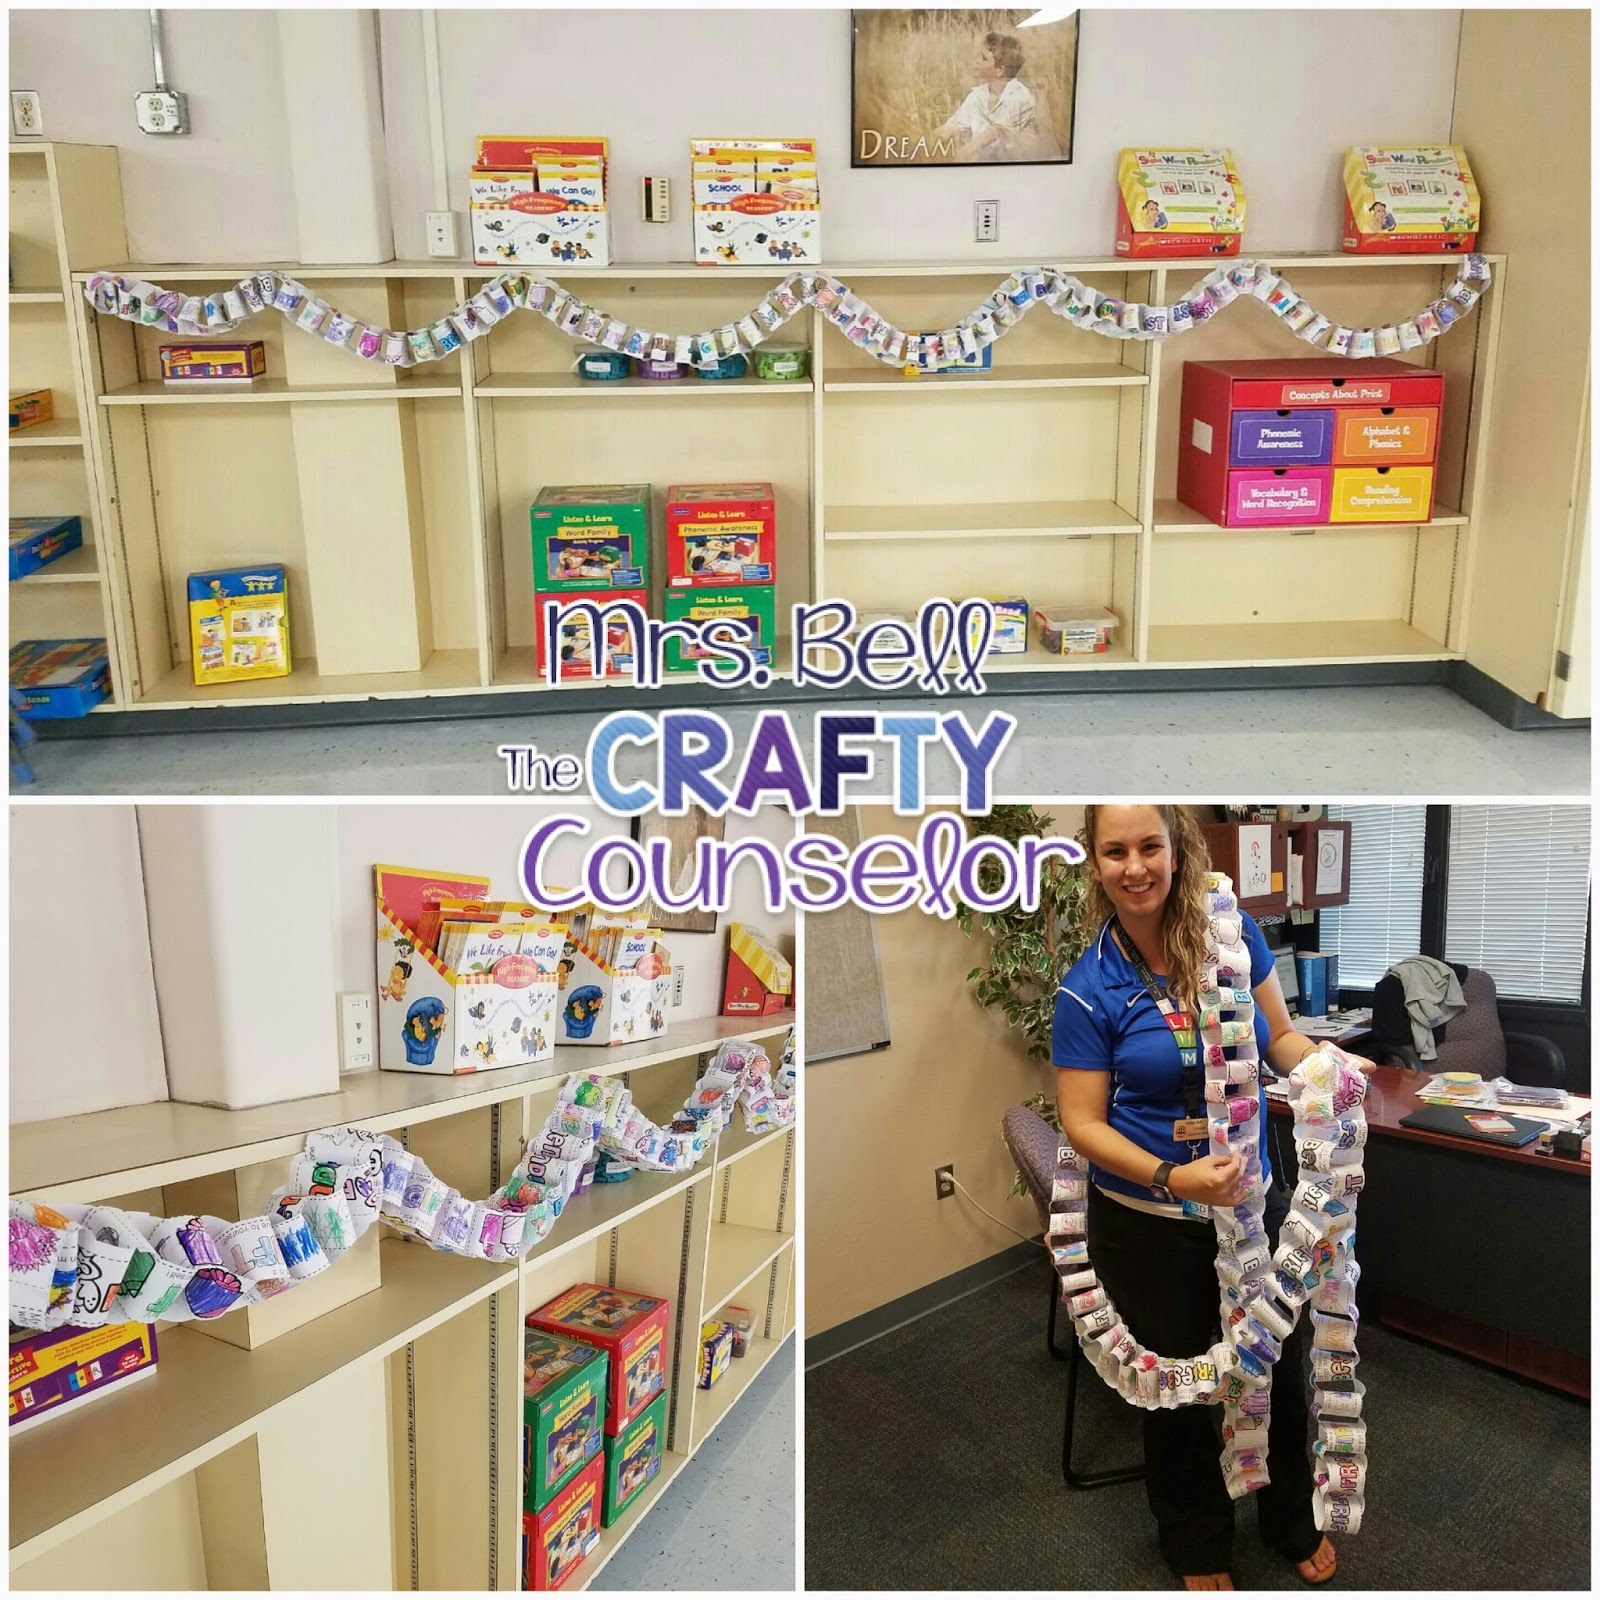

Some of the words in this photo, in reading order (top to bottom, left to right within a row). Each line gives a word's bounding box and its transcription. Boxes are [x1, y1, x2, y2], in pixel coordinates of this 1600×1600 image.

[860, 129, 956, 160] DREAM
[475, 186, 487, 194] We
[490, 185, 507, 194] Like
[562, 186, 578, 194] Can
[580, 187, 596, 197] Go!
[708, 184, 743, 192] SCHOOL
[1396, 233, 1447, 241] SCHOLASTIC
[1289, 390, 1330, 402] Concepts
[1332, 388, 1358, 400] About
[1360, 388, 1383, 399] Print
[1260, 428, 1302, 439] Phonemic
[1362, 426, 1401, 438] Alphabet
[1402, 426, 1411, 435] &
[1257, 439, 1304, 449] Awareness
[1368, 438, 1402, 449] Phonics
[1250, 488, 1299, 500] Vocabulary
[1300, 487, 1309, 497] &
[1241, 498, 1265, 509] Word
[1266, 498, 1316, 511] Recognition
[697, 511, 718, 519] Listen
[726, 510, 746, 518] Learn
[565, 529, 585, 537] Word
[587, 528, 612, 536] Family
[718, 608, 742, 616] Family
[467, 945, 477, 959] We
[480, 944, 495, 956] Like
[534, 946, 545, 956] Can
[546, 946, 558, 959] Go!
[626, 942, 646, 953] SCHOOL
[1184, 1200, 1206, 1213] LCSD
[558, 1411, 571, 1424] Word
[571, 1397, 587, 1412] Family
